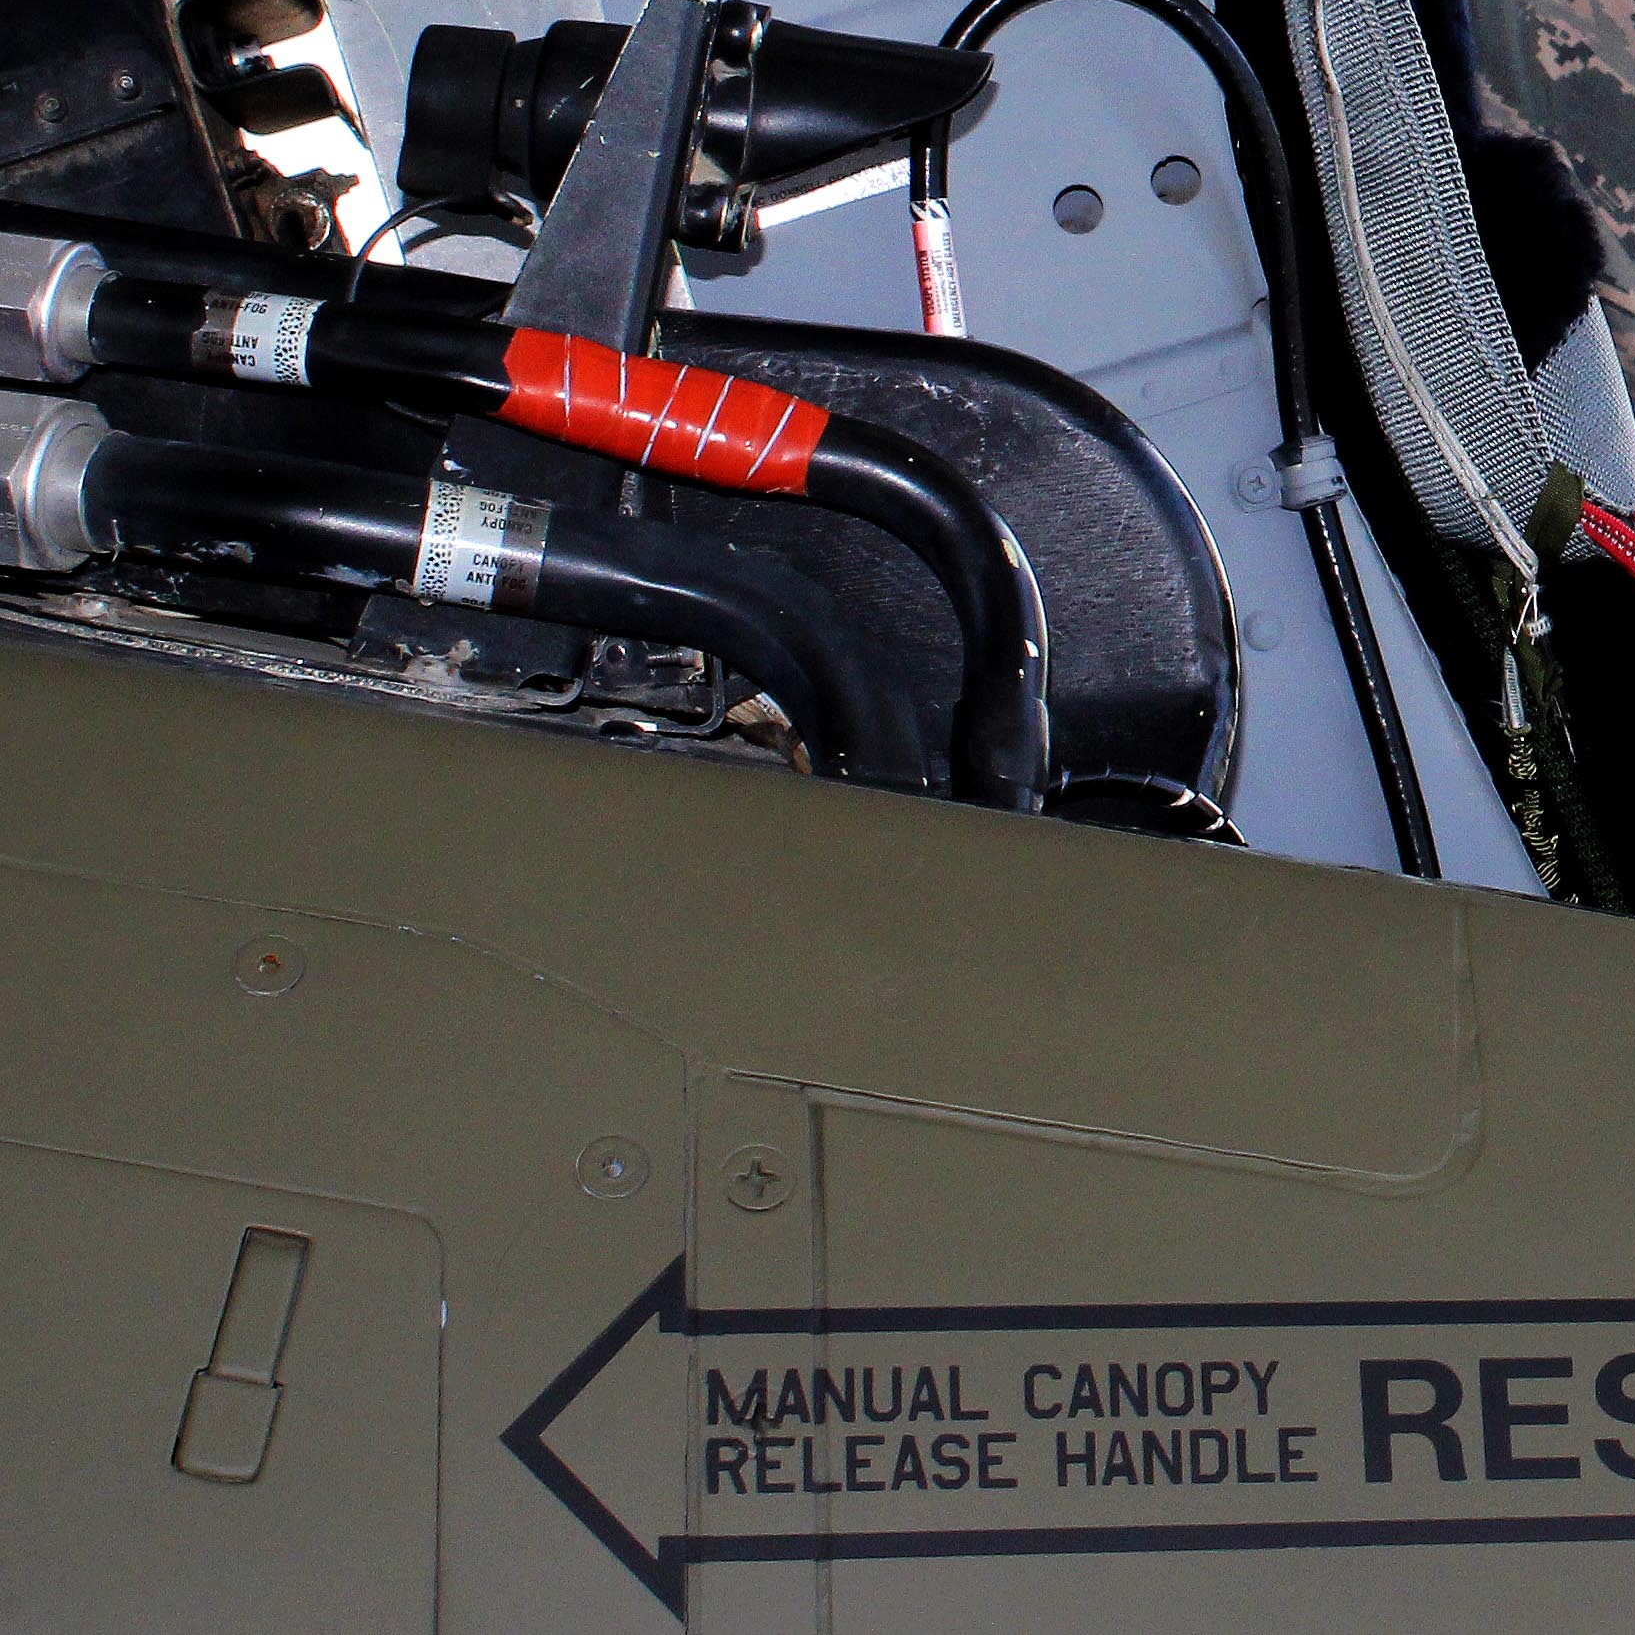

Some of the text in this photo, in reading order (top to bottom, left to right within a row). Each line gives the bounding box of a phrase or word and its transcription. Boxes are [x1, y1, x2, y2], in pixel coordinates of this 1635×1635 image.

[706, 1360, 1280, 1428] MANUAL CANOPY
[705, 1425, 1320, 1495] RELEASE HANDLE
